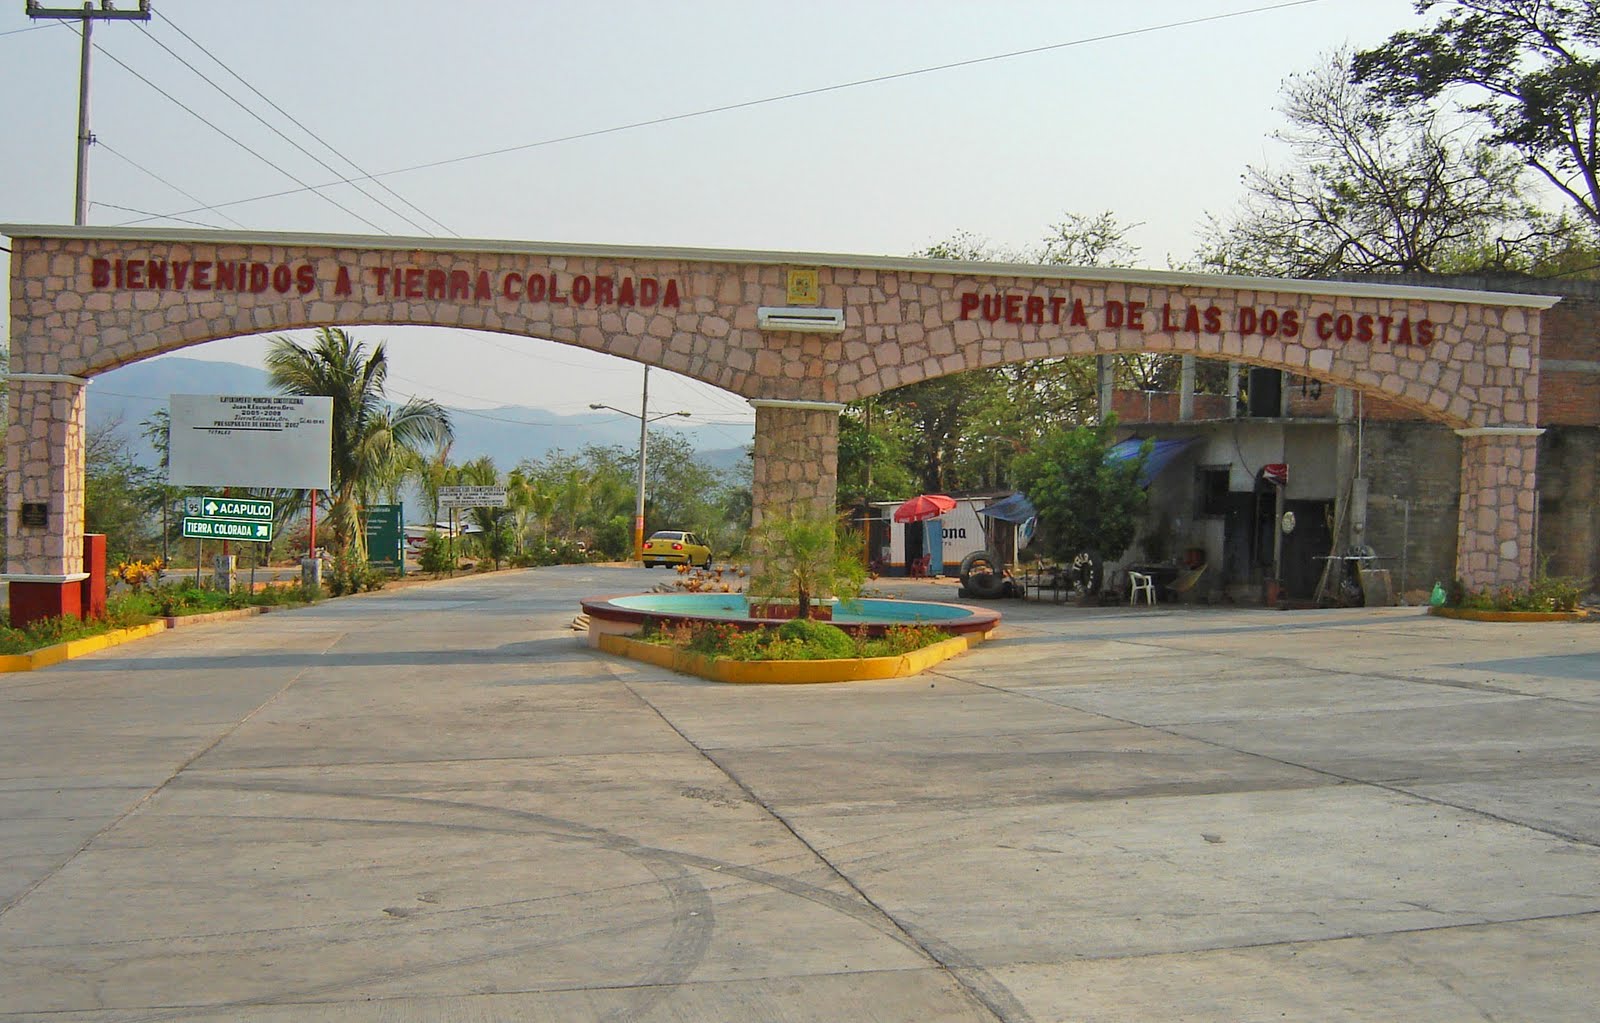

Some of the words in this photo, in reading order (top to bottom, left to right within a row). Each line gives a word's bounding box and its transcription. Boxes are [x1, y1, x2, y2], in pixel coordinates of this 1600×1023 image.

[92, 259, 315, 294] BIENVENIDOS
[335, 266, 352, 295] A
[373, 267, 492, 300] TIERRA
[503, 272, 680, 308] COLORADA
[960, 293, 1087, 326] PUERTA
[1106, 300, 1145, 330] DE
[1162, 303, 1222, 334] LAS
[1240, 307, 1298, 337] DOS
[1316, 313, 1435, 345] COSTAS
[189, 504, 198, 512] 95
[220, 503, 270, 516] ACAPULCO
[187, 522, 212, 534] TIERRA
[214, 524, 252, 536] COLORADA
